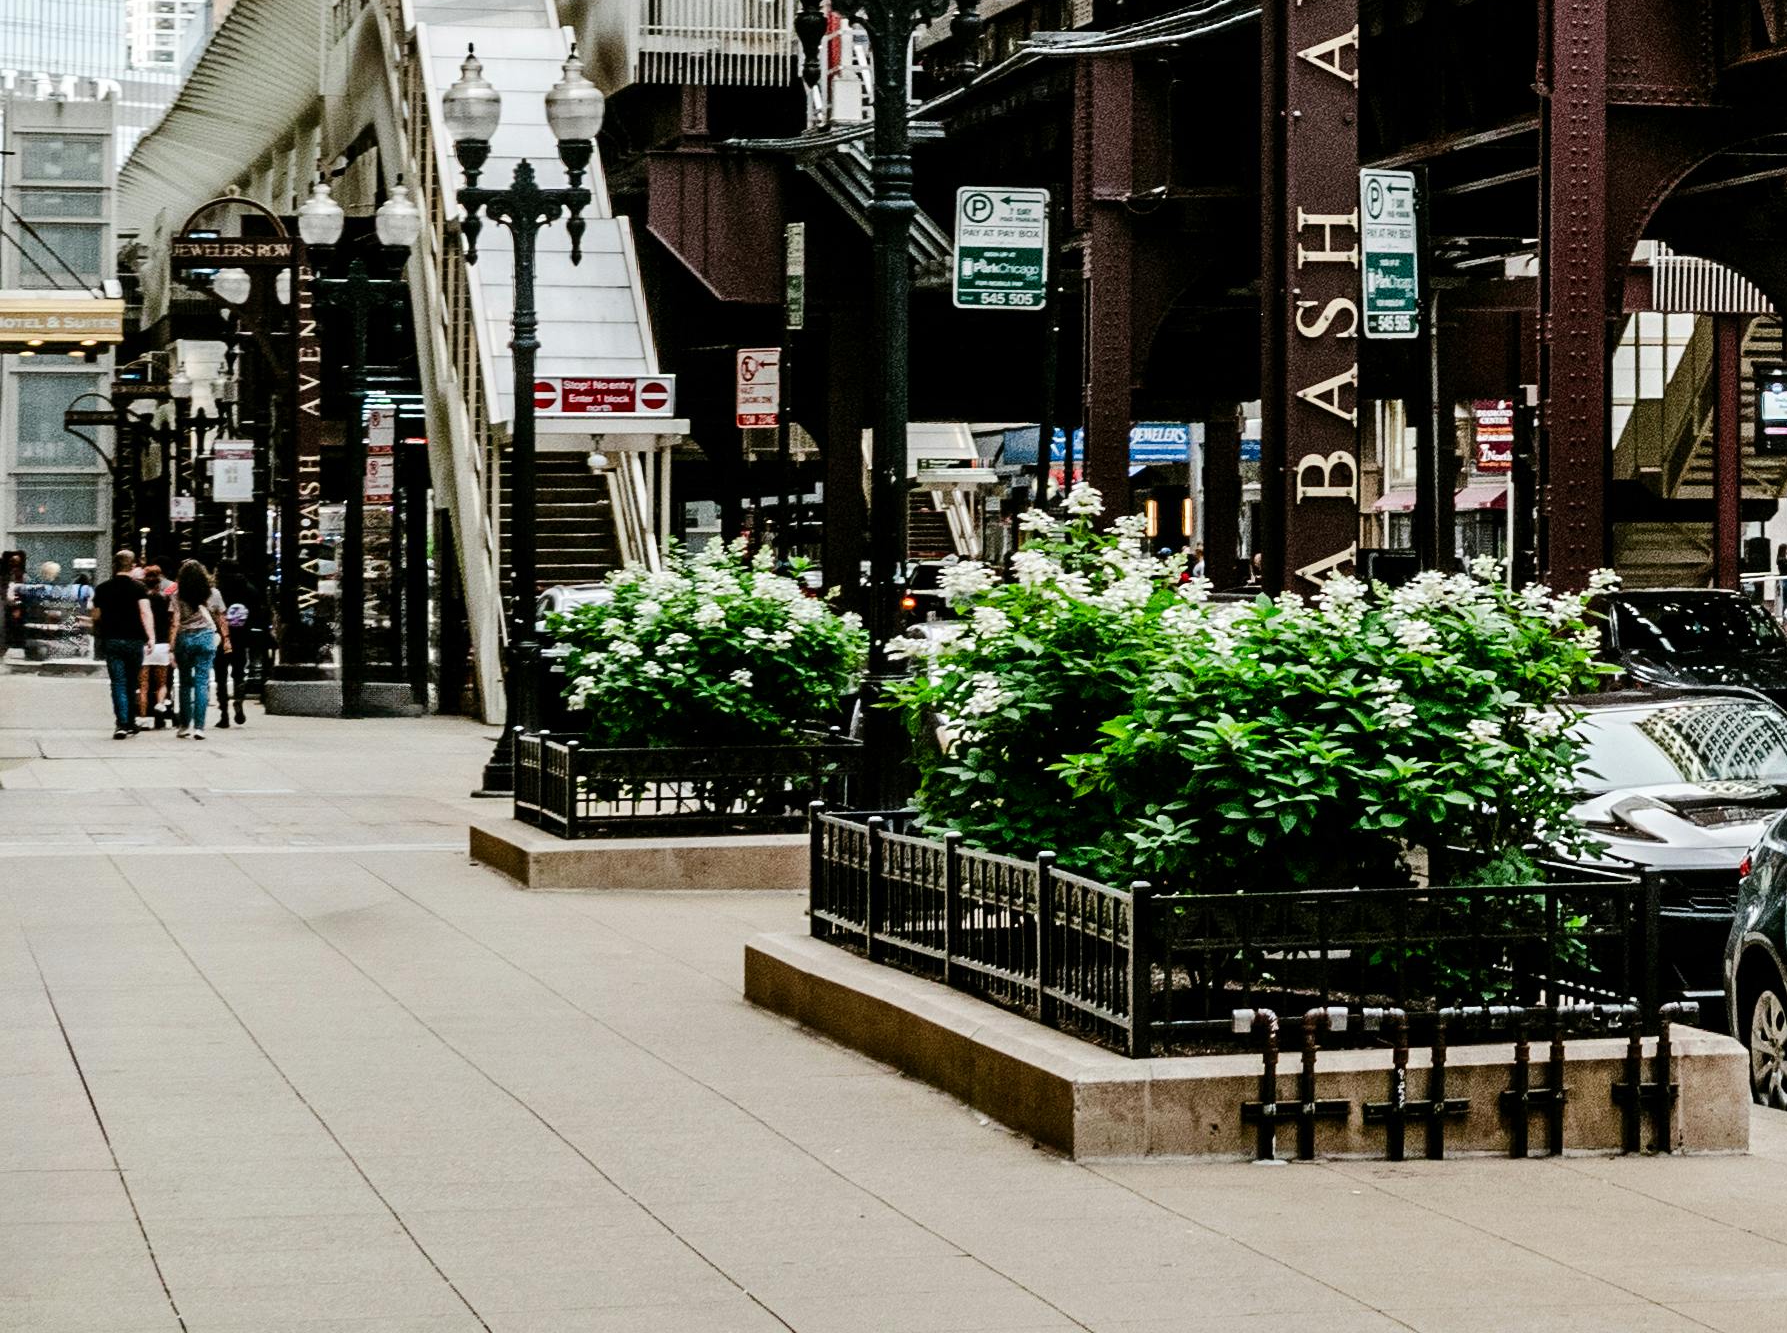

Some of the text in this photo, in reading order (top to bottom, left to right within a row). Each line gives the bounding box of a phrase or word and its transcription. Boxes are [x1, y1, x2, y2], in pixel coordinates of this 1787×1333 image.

[962, 229, 981, 237] PAY
[997, 230, 1016, 238] PAY
[1019, 230, 1040, 238] BOX
[173, 243, 293, 258] JEWELERS ROW
[980, 293, 1034, 305] 545 505
[47, 317, 60, 329] &
[300, 266, 321, 416] AVENUE
[563, 381, 635, 391] Stop! No entry
[568, 394, 594, 403] Enter
[604, 394, 630, 403] block
[1296, 206, 1358, 589] ABASH
[299, 455, 321, 609] WABASH
